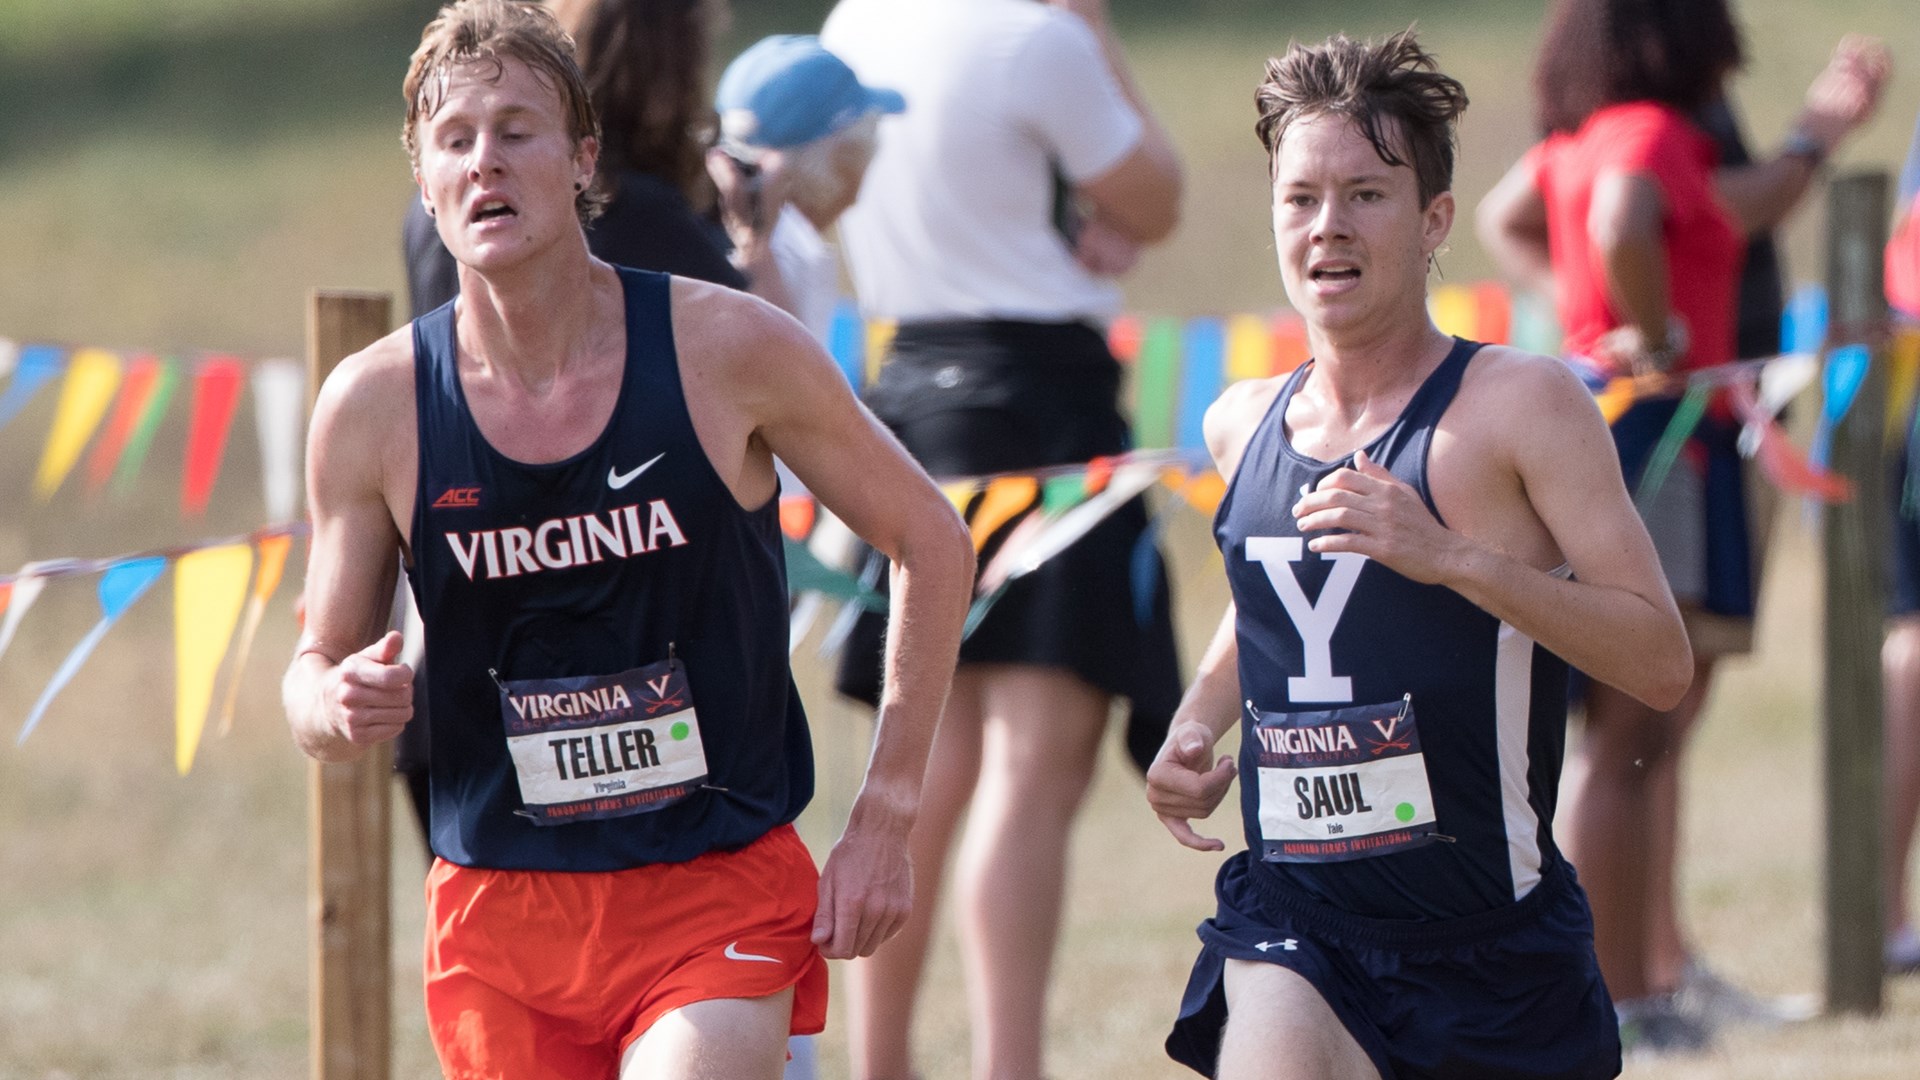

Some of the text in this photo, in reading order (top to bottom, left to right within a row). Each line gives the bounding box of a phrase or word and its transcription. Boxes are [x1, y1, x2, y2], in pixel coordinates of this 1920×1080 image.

[432, 488, 481, 508] ACC
[445, 499, 689, 582] VIRGINIA
[1245, 537, 1371, 702] Y
[508, 684, 632, 720] VIRGINIA
[548, 728, 661, 780] TELLER
[1256, 725, 1358, 754] VIRGINIA
[547, 786, 687, 817] PANORAMA FARMS INVITATIONAL
[593, 779, 626, 794] Virginia
[1294, 772, 1372, 820] SAUL
[1321, 841, 1348, 854] FARMS
[1350, 831, 1413, 852] INVITATIONAL
[1326, 823, 1344, 835] Yale
